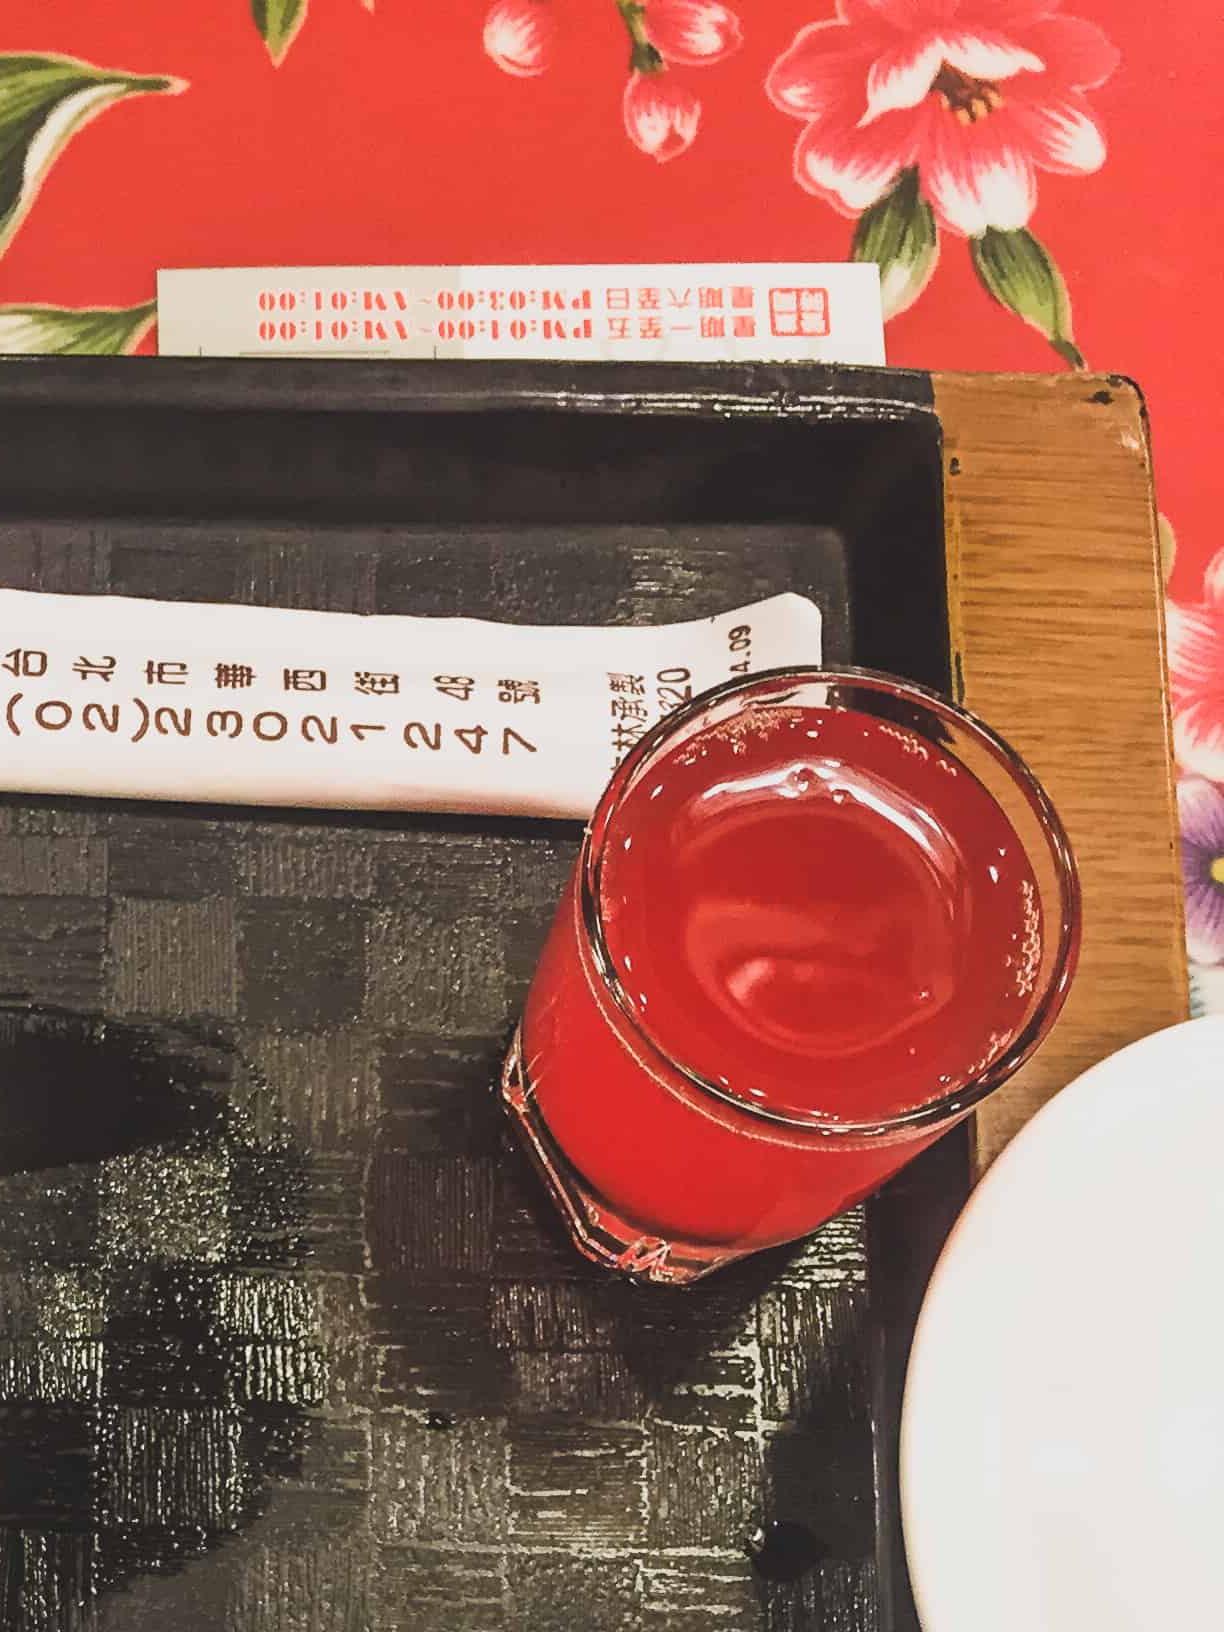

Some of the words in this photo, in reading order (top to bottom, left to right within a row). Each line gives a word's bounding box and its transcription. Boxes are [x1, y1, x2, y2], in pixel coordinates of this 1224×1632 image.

[606, 286, 755, 310] 星期六至日
[608, 316, 756, 340] 星期一至五
